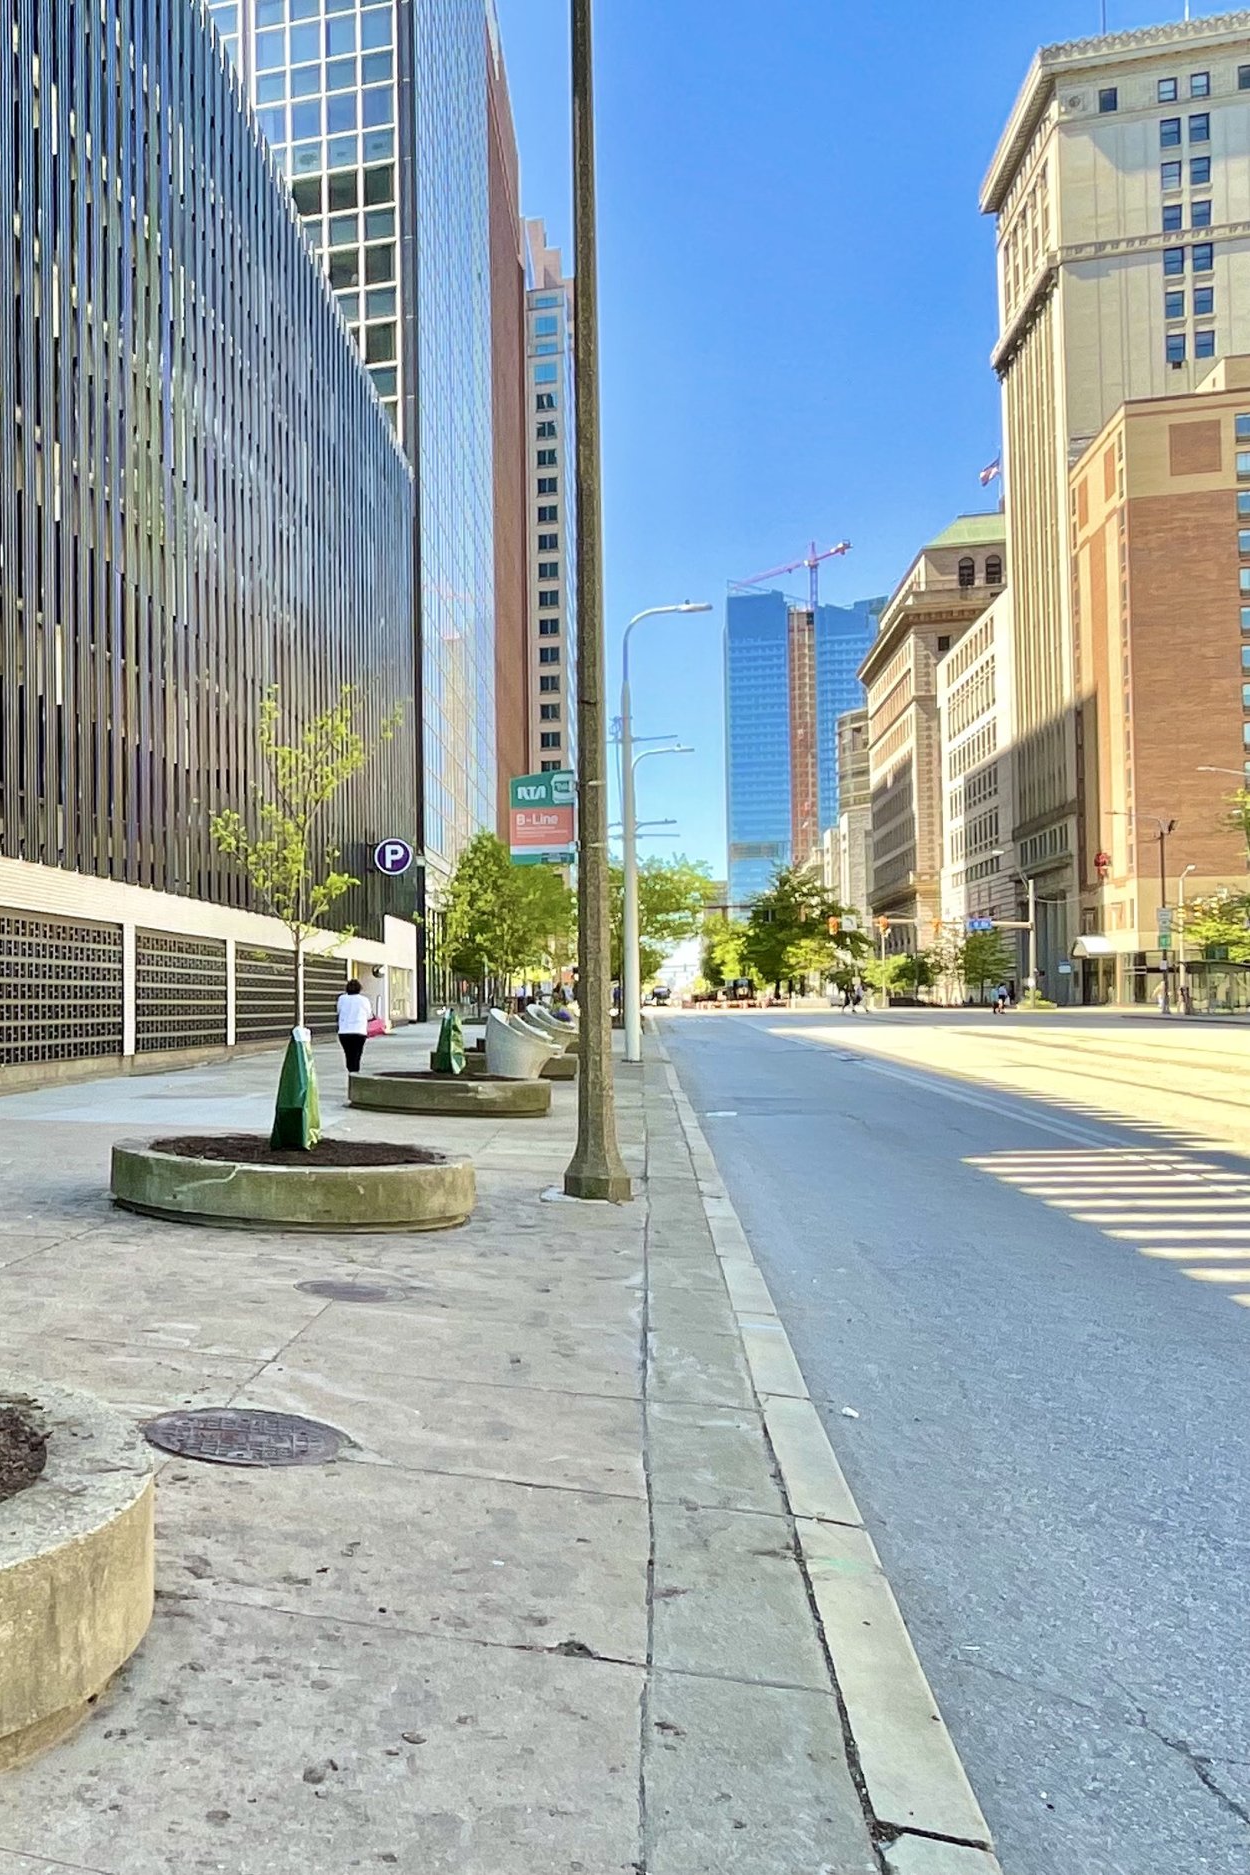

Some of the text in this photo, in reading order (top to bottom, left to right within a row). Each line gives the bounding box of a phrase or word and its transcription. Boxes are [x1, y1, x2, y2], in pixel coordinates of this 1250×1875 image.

[517, 785, 547, 800] RTA
[516, 813, 559, 826] B-Line
[385, 844, 405, 869] P
